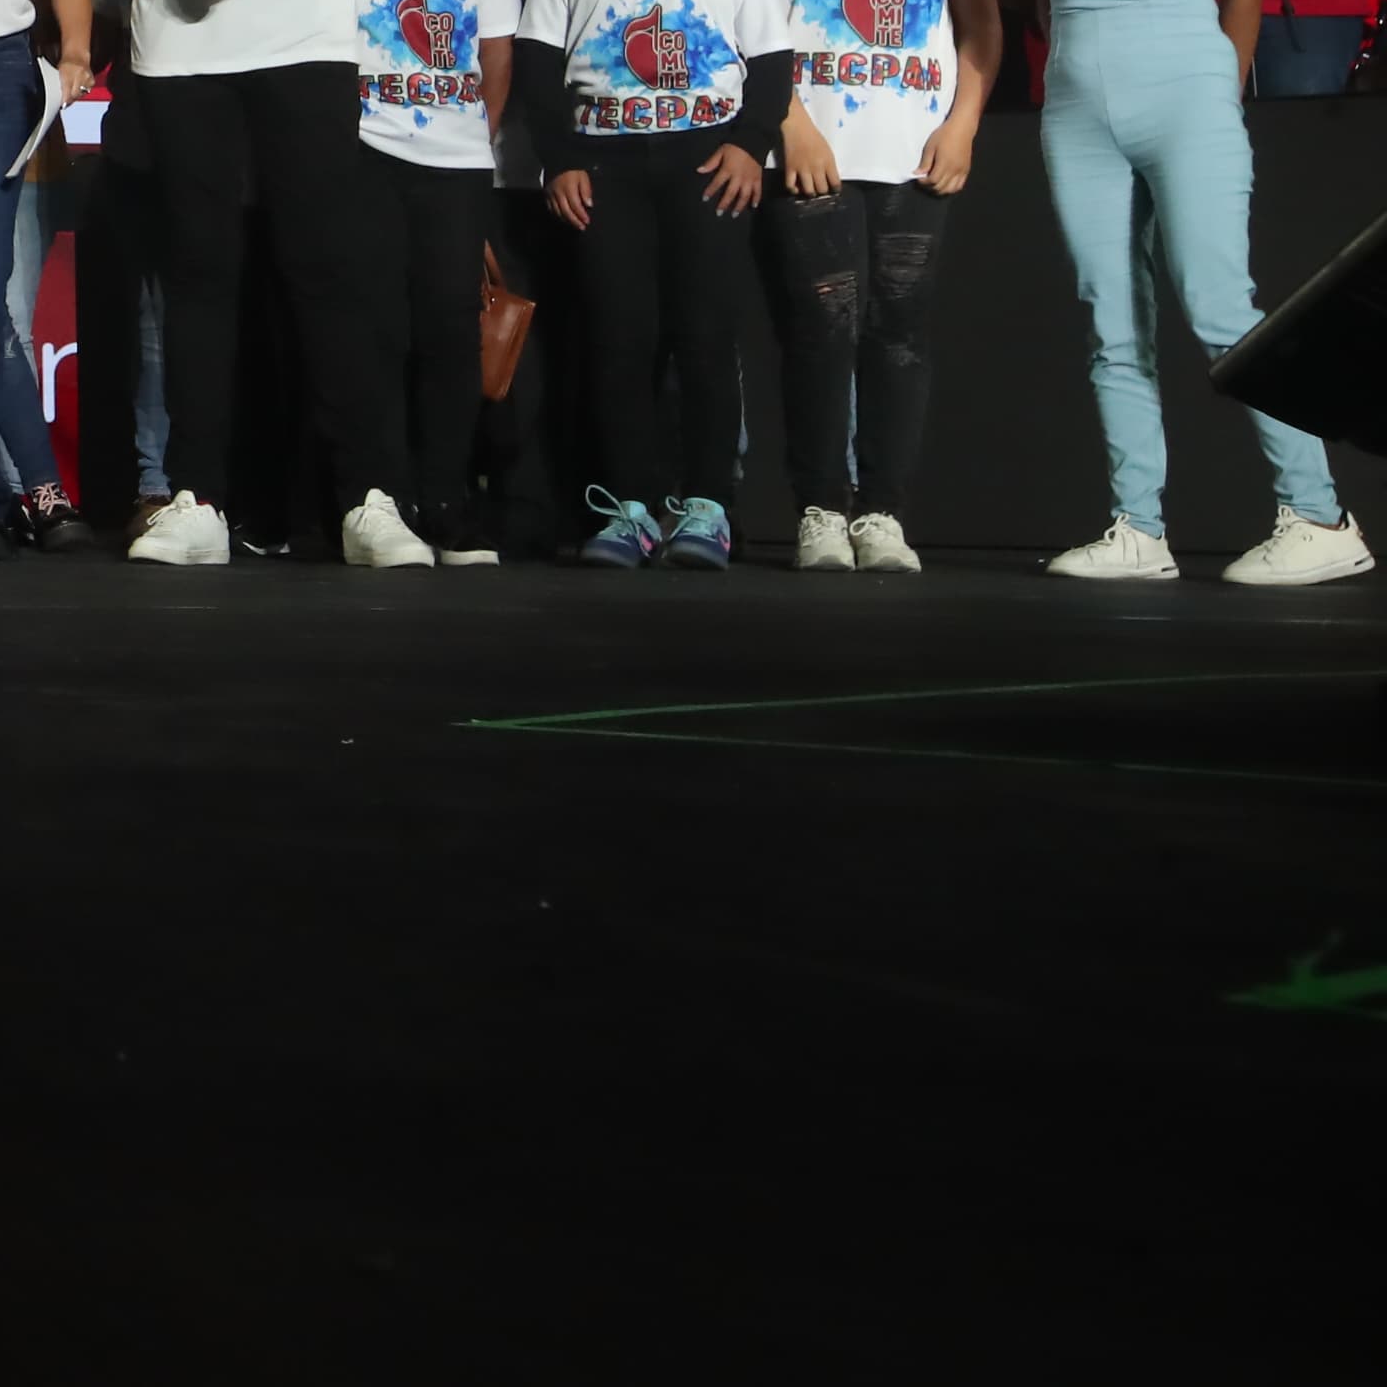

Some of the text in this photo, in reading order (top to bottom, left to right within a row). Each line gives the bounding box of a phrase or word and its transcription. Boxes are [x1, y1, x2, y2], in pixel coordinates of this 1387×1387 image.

[427, 13, 455, 33] CO
[878, 6, 903, 26] MI
[658, 31, 686, 51] CO
[877, 26, 903, 46] TE
[660, 51, 687, 71] MI
[661, 71, 689, 89] TE
[793, 52, 942, 91] TECPAN
[358, 71, 482, 105] TECPA
